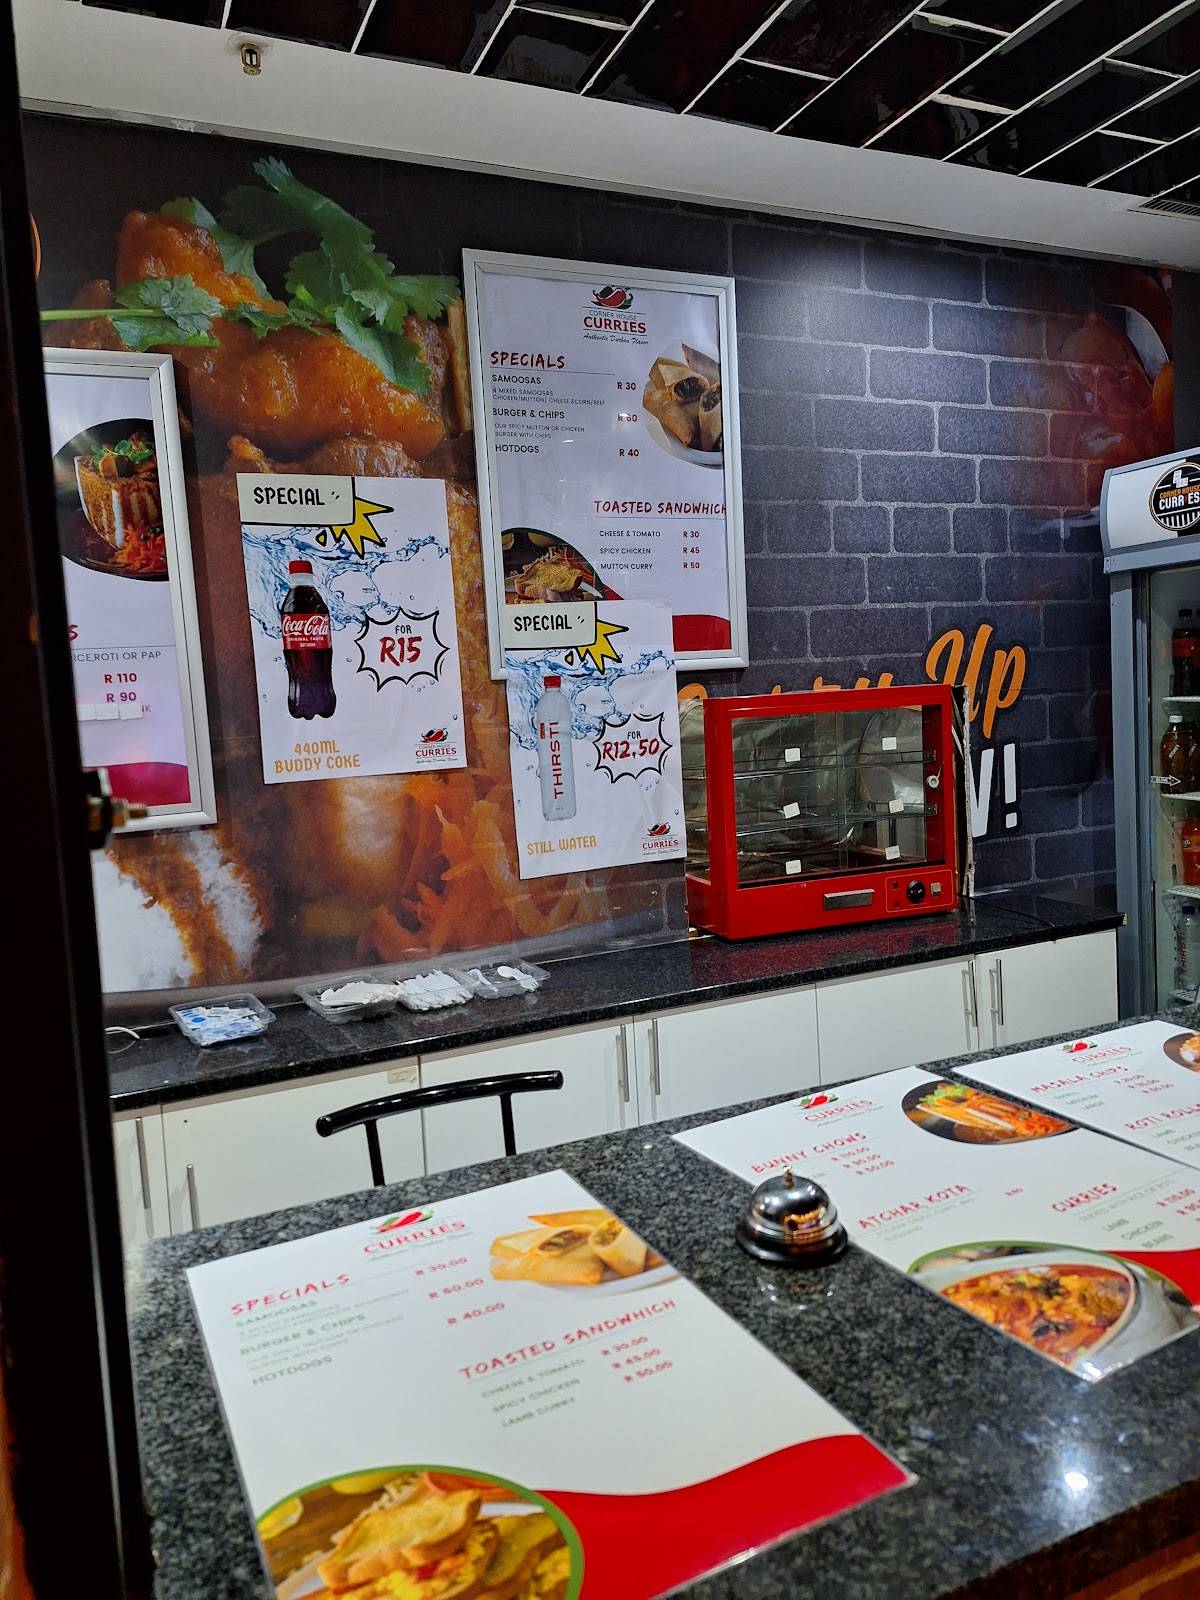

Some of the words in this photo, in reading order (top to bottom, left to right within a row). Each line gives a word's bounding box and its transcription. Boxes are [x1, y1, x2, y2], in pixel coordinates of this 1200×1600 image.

[589, 310, 614, 318] CORNER
[583, 317, 646, 333] CURRIES
[490, 351, 565, 369] SPECIALS
[492, 375, 542, 385] SAMOOSAS
[617, 382, 623, 390] R
[625, 382, 636, 390] 30
[519, 389, 554, 397] SAMOOSAS
[492, 407, 527, 418] BURGER
[529, 410, 536, 418] &
[538, 410, 565, 419] CHIPS
[495, 444, 540, 454] HOTDOGS
[627, 449, 640, 457] 40
[253, 487, 326, 506] SPECIAL
[594, 500, 652, 514] TOASTED
[657, 502, 727, 515] SANDWHICH
[395, 625, 412, 635] FOR
[513, 614, 572, 632] SPECIAL
[122, 652, 137, 660] OR
[141, 650, 162, 659] PAP
[379, 636, 423, 667] R15
[104, 674, 113, 684] R
[116, 672, 137, 683] 110
[106, 693, 115, 703] R
[119, 691, 137, 702] 90
[627, 731, 642, 740] FOR
[416, 747, 457, 757] CURRIES
[549, 722, 564, 799] THIRSTI
[274, 757, 322, 774] BUDDY
[326, 754, 361, 769] COKE
[527, 841, 555, 855] STILL
[559, 835, 597, 851] WATER
[642, 840, 679, 849] CURRIES
[1031, 1075, 1088, 1094] MASALA
[1089, 1065, 1128, 1078] CHIPS
[804, 1099, 873, 1122] CURRIES
[1124, 1115, 1163, 1130] ROTI
[751, 1150, 808, 1174] BUNNY
[812, 1131, 867, 1154] CHOWS
[858, 1200, 921, 1229] ATCHAR
[924, 1184, 971, 1204] KOTA
[1052, 1183, 1118, 1213] CURRIES
[364, 1221, 465, 1254] CURRIES
[230, 1272, 351, 1316] SPECIALS
[236, 1300, 318, 1327] SAMOOSAS
[241, 1332, 302, 1355] BURGER
[321, 1313, 366, 1332] CHIPS
[252, 1356, 333, 1385] HOTDOGS
[463, 1302, 505, 1320] 40.00
[458, 1339, 556, 1380] TOASTED
[562, 1300, 677, 1345] SANDWHICH
[537, 1359, 585, 1378] TOMATO
[528, 1379, 580, 1400] CHICKEN
